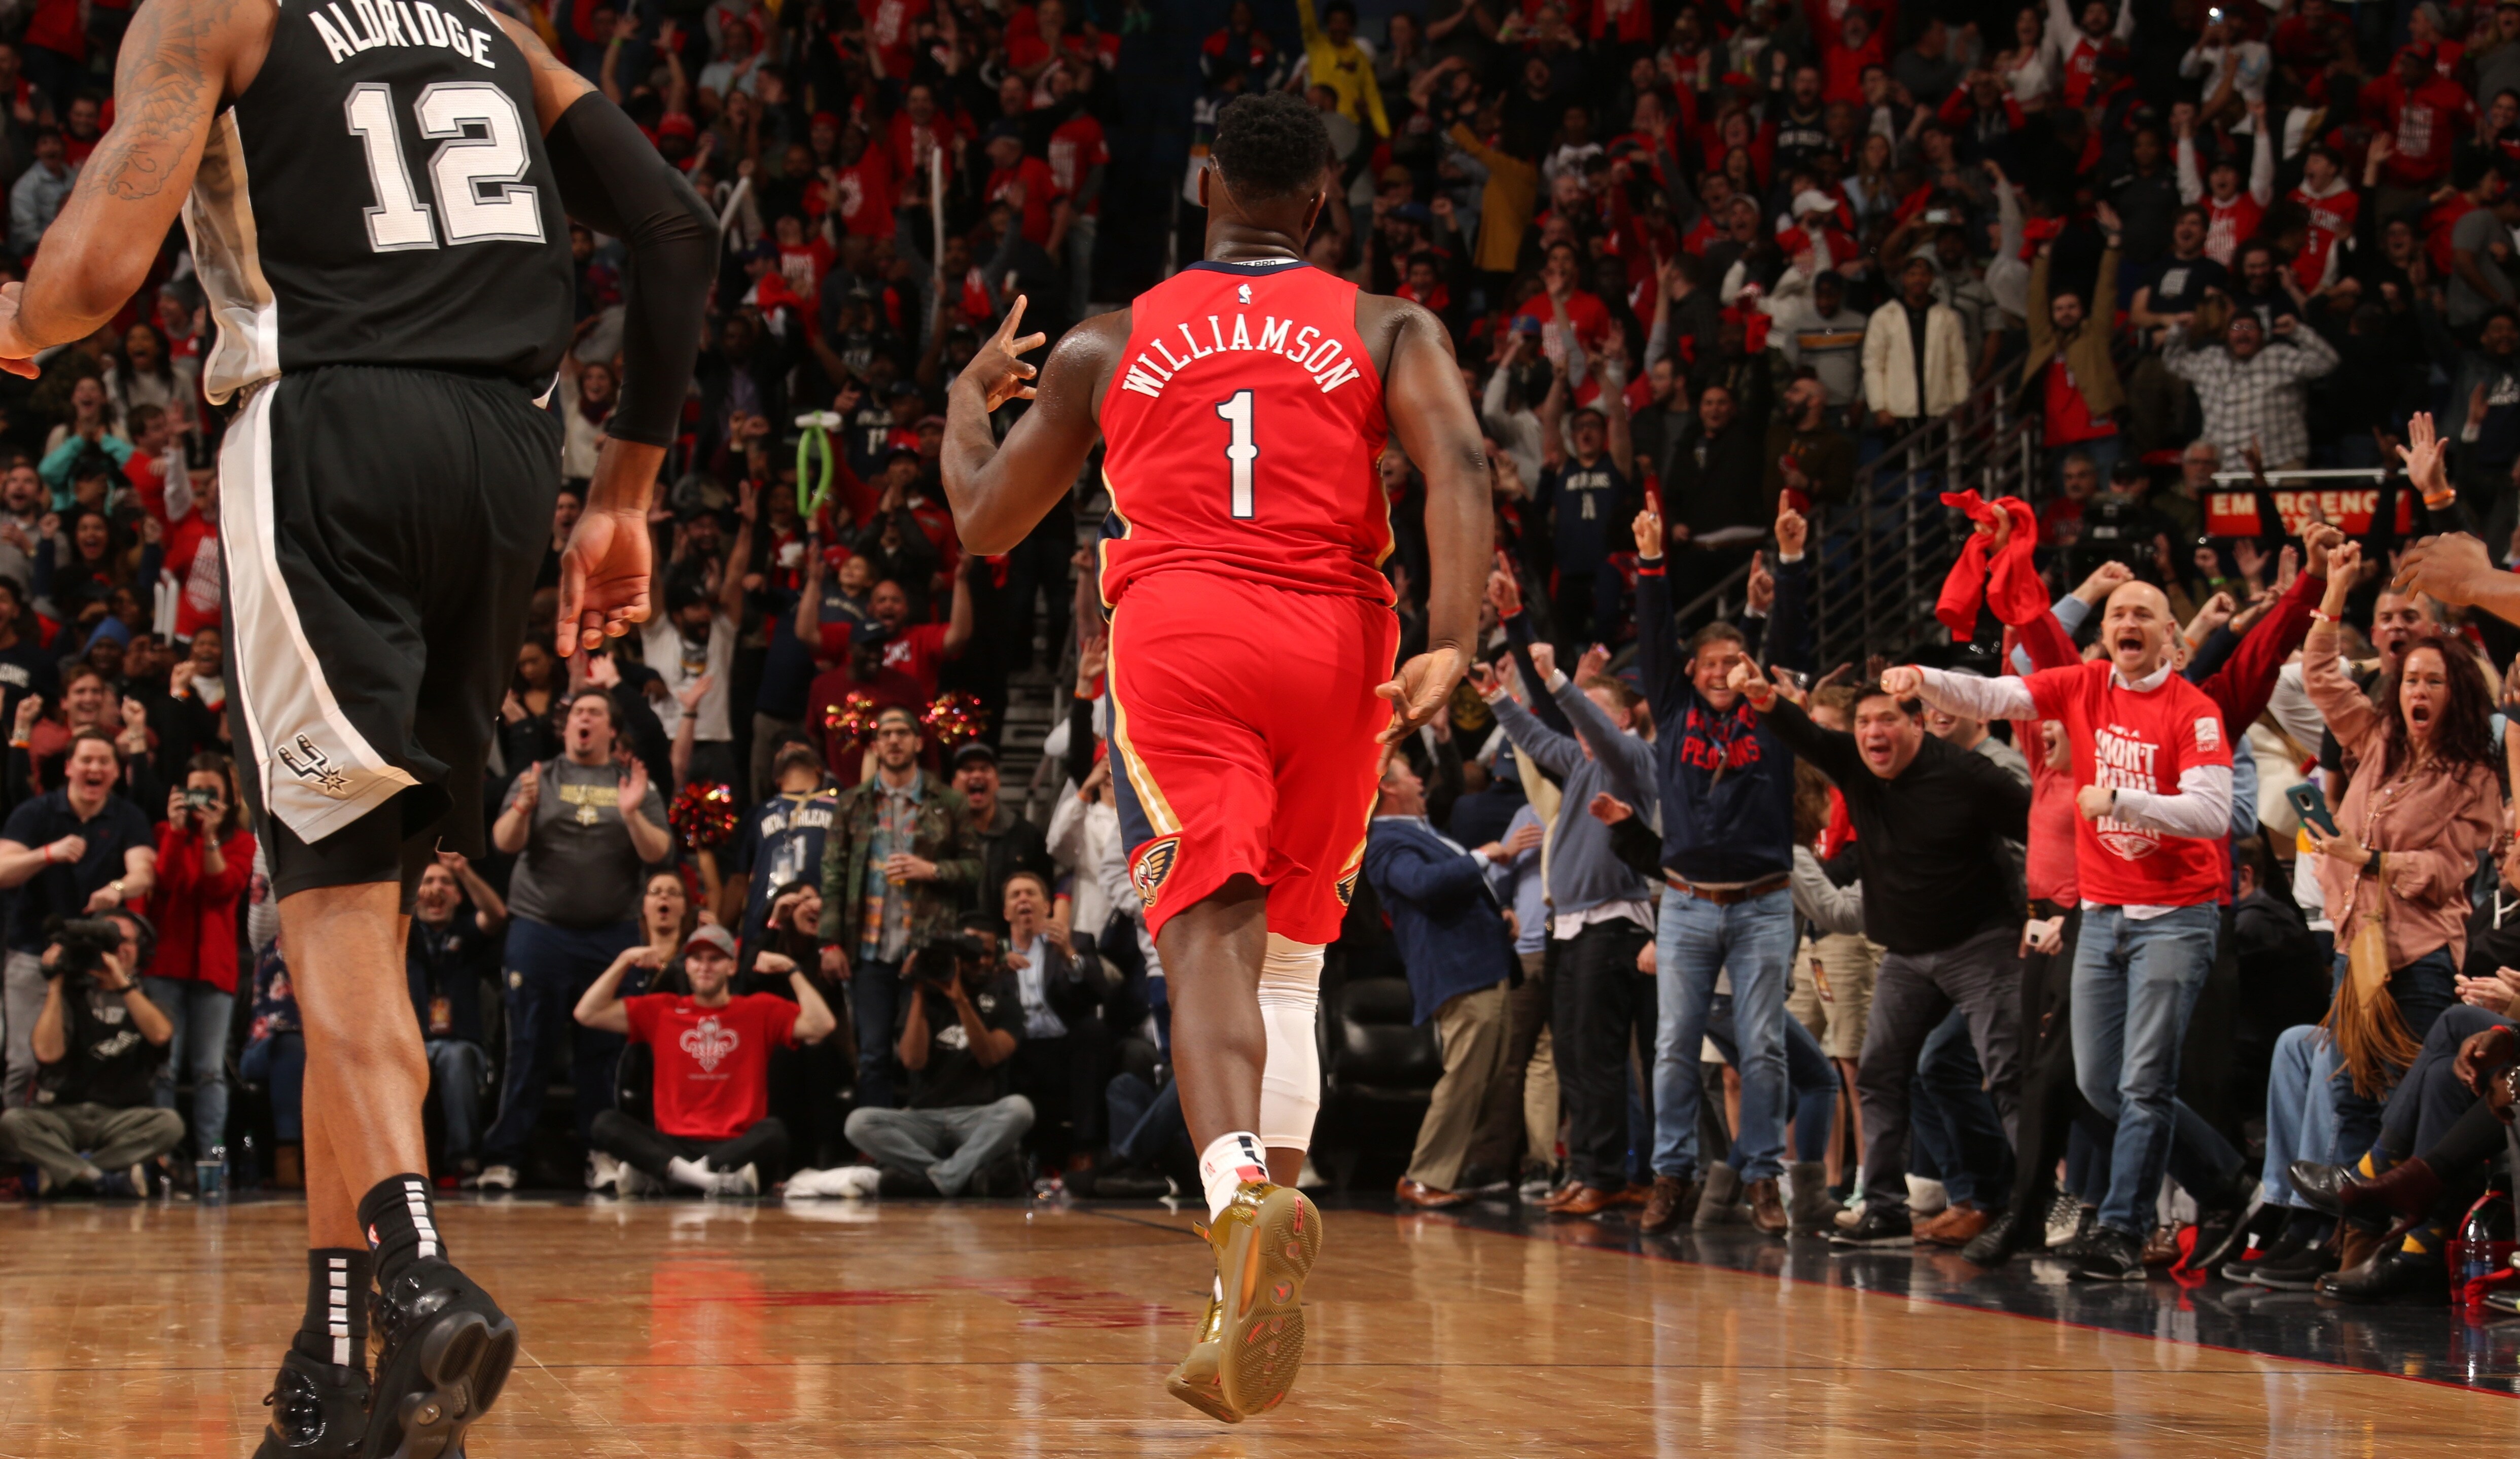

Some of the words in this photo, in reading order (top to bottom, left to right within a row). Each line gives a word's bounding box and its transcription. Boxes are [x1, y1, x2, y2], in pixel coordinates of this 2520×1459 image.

[308, 0, 495, 69] ALDRIDGE
[344, 81, 547, 253] 12
[1121, 313, 1361, 398] WILLIAMSON
[1215, 388, 1260, 519] 1
[2211, 490, 2404, 516] EMRGENC
